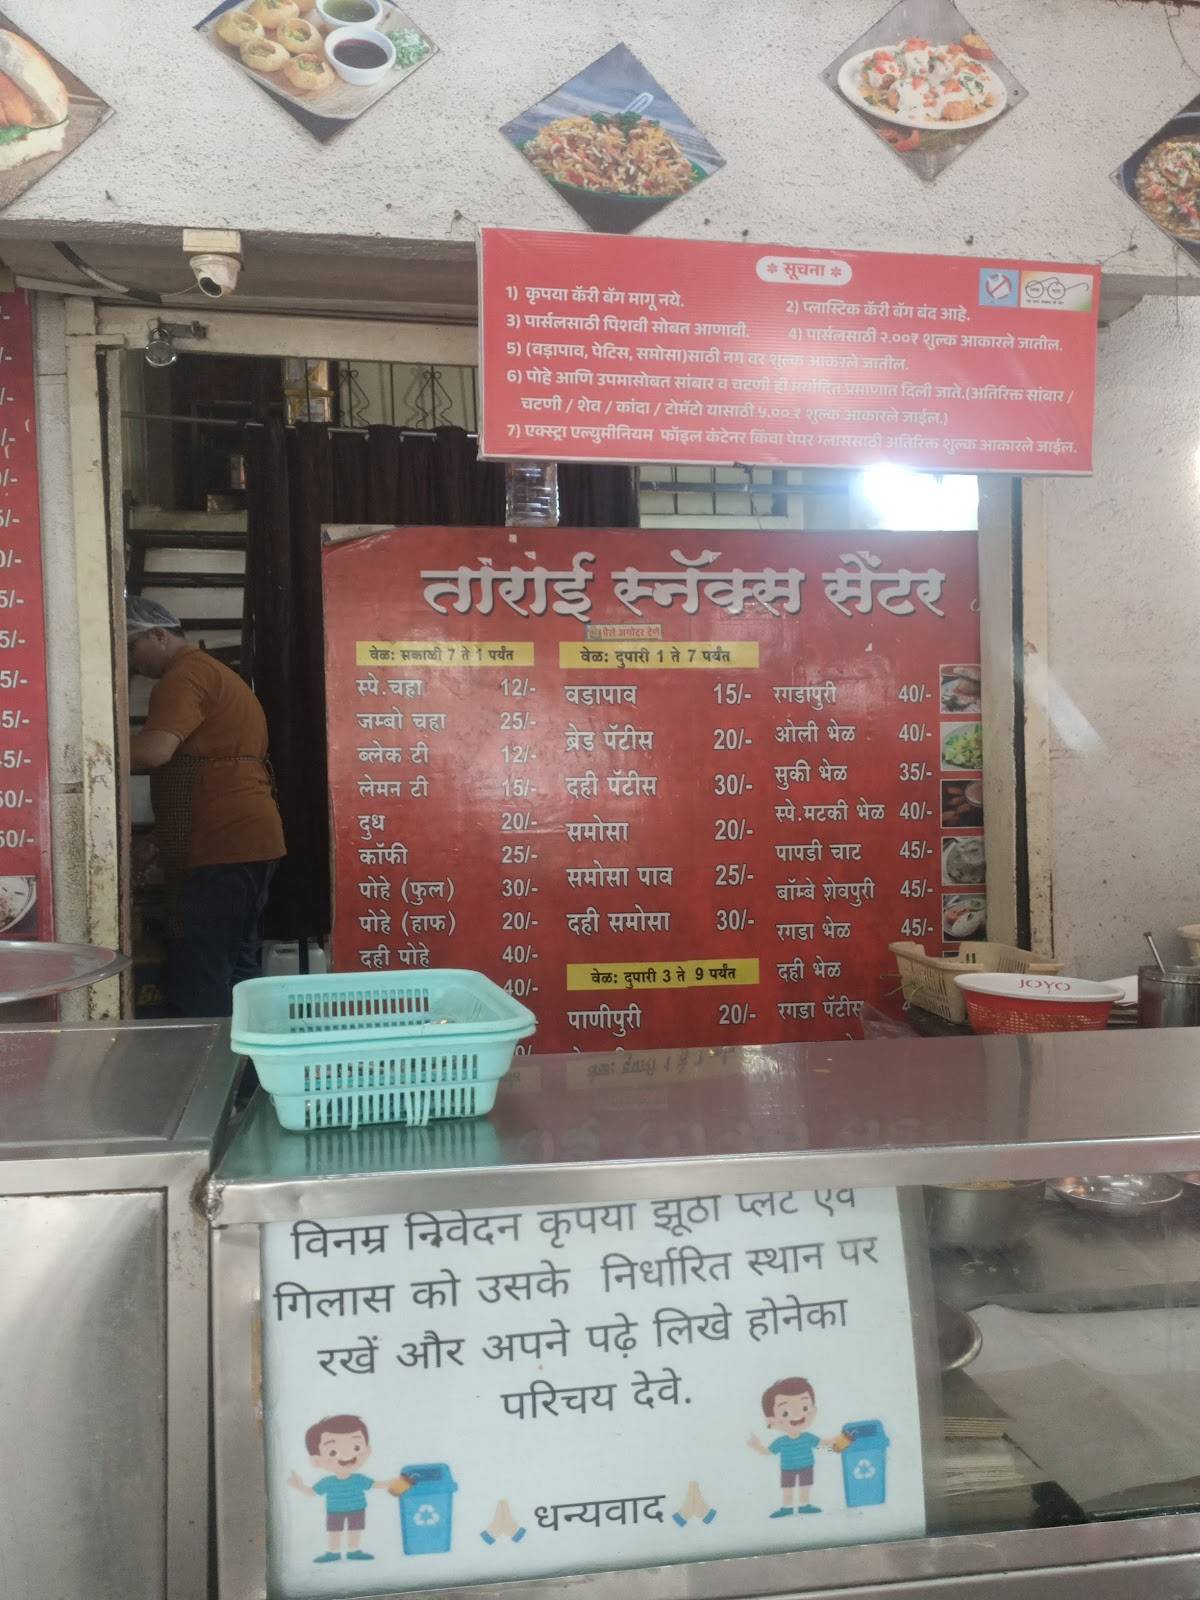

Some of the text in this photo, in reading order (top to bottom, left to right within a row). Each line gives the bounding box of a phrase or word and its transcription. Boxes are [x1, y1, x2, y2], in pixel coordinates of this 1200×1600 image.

[783, 262, 825, 280] सूचना
[506, 285, 684, 310] 1) कृपया कॅरी बॅग मागू नये.
[785, 299, 970, 322] 2) प्लास्टिक कॅरी बॅग बंद आहे.
[506, 312, 750, 338] 3) पार्सलसाठी पिशवी सोबत आणावी.
[507, 342, 521, 356] 5)
[789, 325, 1063, 351] 4) पार्सलसाठी शुल्क आकारले जातील.
[507, 370, 522, 383] 6)
[527, 367, 552, 384] पोहे
[556, 368, 593, 386] आणि
[597, 370, 671, 389] उपमासोबत
[675, 374, 713, 390] सांबार
[717, 378, 728, 390] व
[521, 395, 562, 412] चटणी
[577, 396, 600, 413] शेव
[616, 398, 650, 415] कांदा
[508, 425, 521, 438] 7)
[660, 427, 702, 444] फॉइल
[706, 427, 746, 444] कंटेनर
[1036, 438, 1078, 455] जाईल.
[822, 551, 946, 617] सेंटर
[369, 645, 395, 661] वेळ:
[461, 646, 471, 661] ते
[581, 646, 608, 663] वेळ:
[615, 649, 650, 668] दुपारी
[670, 647, 680, 663] ते
[688, 649, 696, 662] 7
[388, 678, 536, 698] चहा 12/-
[564, 683, 752, 705] वडापाव 15/-
[773, 681, 932, 710] रगडापुरी 40/-
[357, 706, 536, 732] जम्बो चहा 25/-
[776, 719, 932, 743] ओली भेळ 40/-
[565, 724, 752, 752] ब्रेड पॅटीस 20/-
[358, 740, 537, 764] ब्लेक टी 12/-
[358, 774, 537, 797] लेमन टी 15/-
[565, 768, 752, 797] दही पॅटीस 30/-
[774, 758, 932, 789] सुकी भेळ 35/-
[856, 798, 933, 820] भेळ 40/-
[358, 811, 538, 840] दुध 20/-
[566, 814, 753, 842] समोसा 20/-
[358, 841, 538, 865] कॉफी 25/-
[775, 838, 933, 862] पापडी चाट 45/-
[566, 860, 754, 888] समोसा पाव 25/-
[359, 875, 390, 900] पोहे
[502, 879, 538, 897] 30/-
[776, 876, 933, 907] बॉम्बे शेवपुरी 45/-
[359, 909, 390, 934] पोहे
[502, 913, 538, 930] 20/-
[566, 904, 754, 935] दही समोसा 30/-
[776, 916, 933, 941] रगडा भेळ 45/-
[360, 942, 538, 968] दही पोहे 40/-
[591, 968, 618, 984] वेळ:
[624, 969, 656, 989] दुपारी
[662, 969, 671, 982] 3
[676, 967, 686, 982] ते
[695, 967, 704, 980] 9
[777, 955, 841, 983] दही भेळ
[1019, 979, 1071, 991] JOYO
[567, 1002, 757, 1037] पाणीपुरी 20/-
[778, 1002, 815, 1020] रगडा
[290, 1220, 389, 1260] विनम्र
[537, 1203, 637, 1249] कृपया
[651, 1195, 721, 1237] झूठा
[273, 1237, 878, 1320] गिलास को उसके निर्धारित स्थान पर
[318, 1295, 848, 1376] रखें और अपने पढ़े लिखे होनेका
[500, 1367, 692, 1419] परिचय देवे.
[534, 1495, 666, 1531] धन्यवाद
